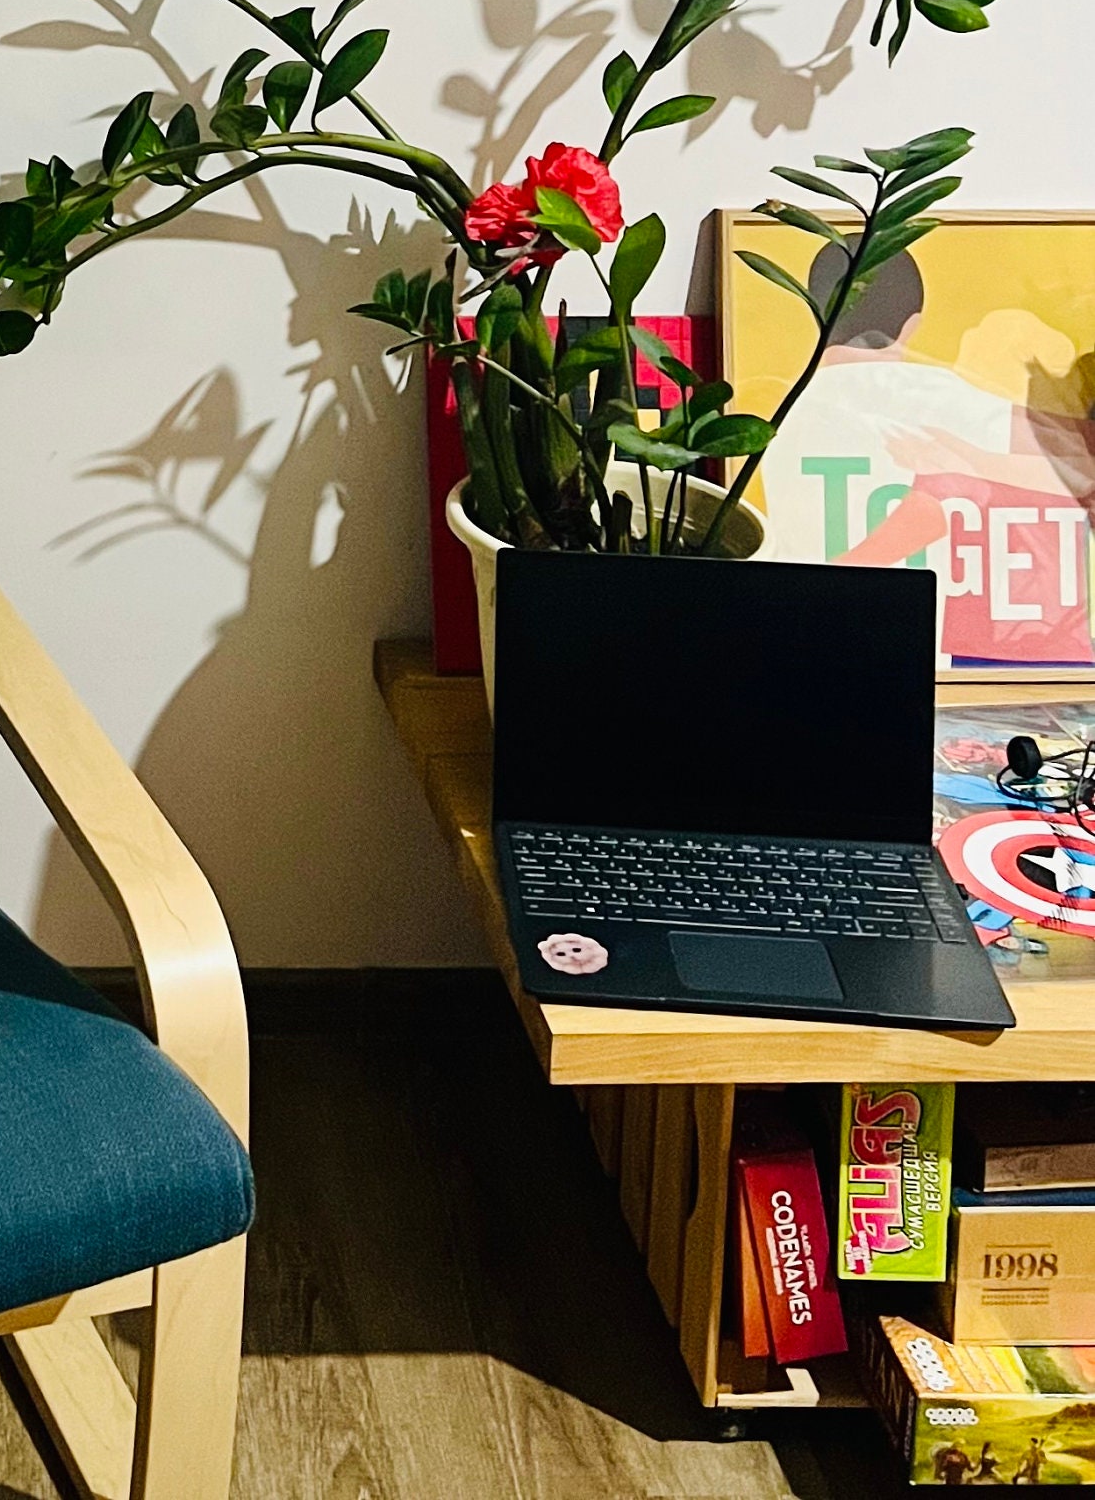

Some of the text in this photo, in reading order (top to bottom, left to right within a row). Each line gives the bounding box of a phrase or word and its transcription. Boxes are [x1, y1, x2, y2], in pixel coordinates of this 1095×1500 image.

[902, 1122, 925, 1250] СУМАСШЕДШАЯ
[922, 1151, 941, 1212] ВЕРСИЯ
[771, 1190, 813, 1325] CODENAMES
[983, 1252, 1058, 1280] 1998
